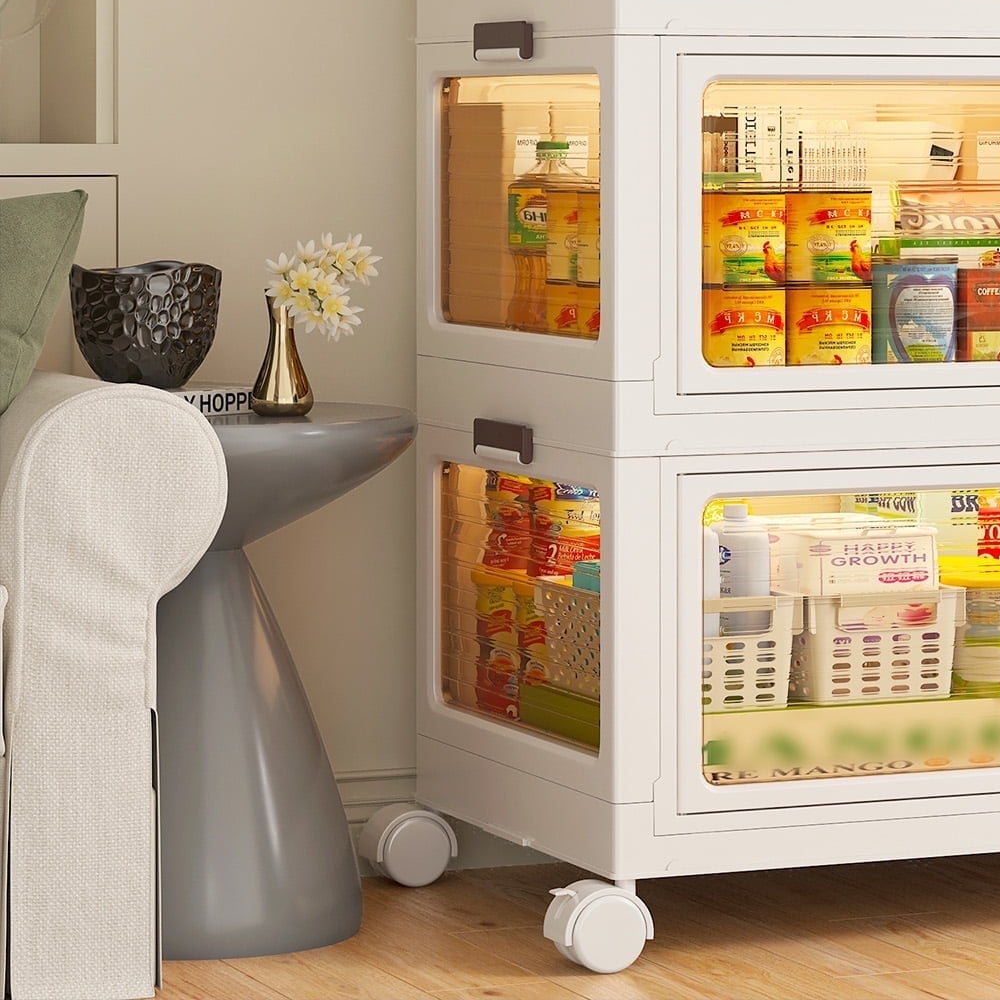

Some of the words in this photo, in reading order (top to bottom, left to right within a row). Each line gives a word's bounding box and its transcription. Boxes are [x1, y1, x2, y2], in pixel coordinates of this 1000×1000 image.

[844, 542, 916, 555] HAPPY
[831, 553, 926, 566] GROWTH
[772, 760, 914, 778] MANGO
